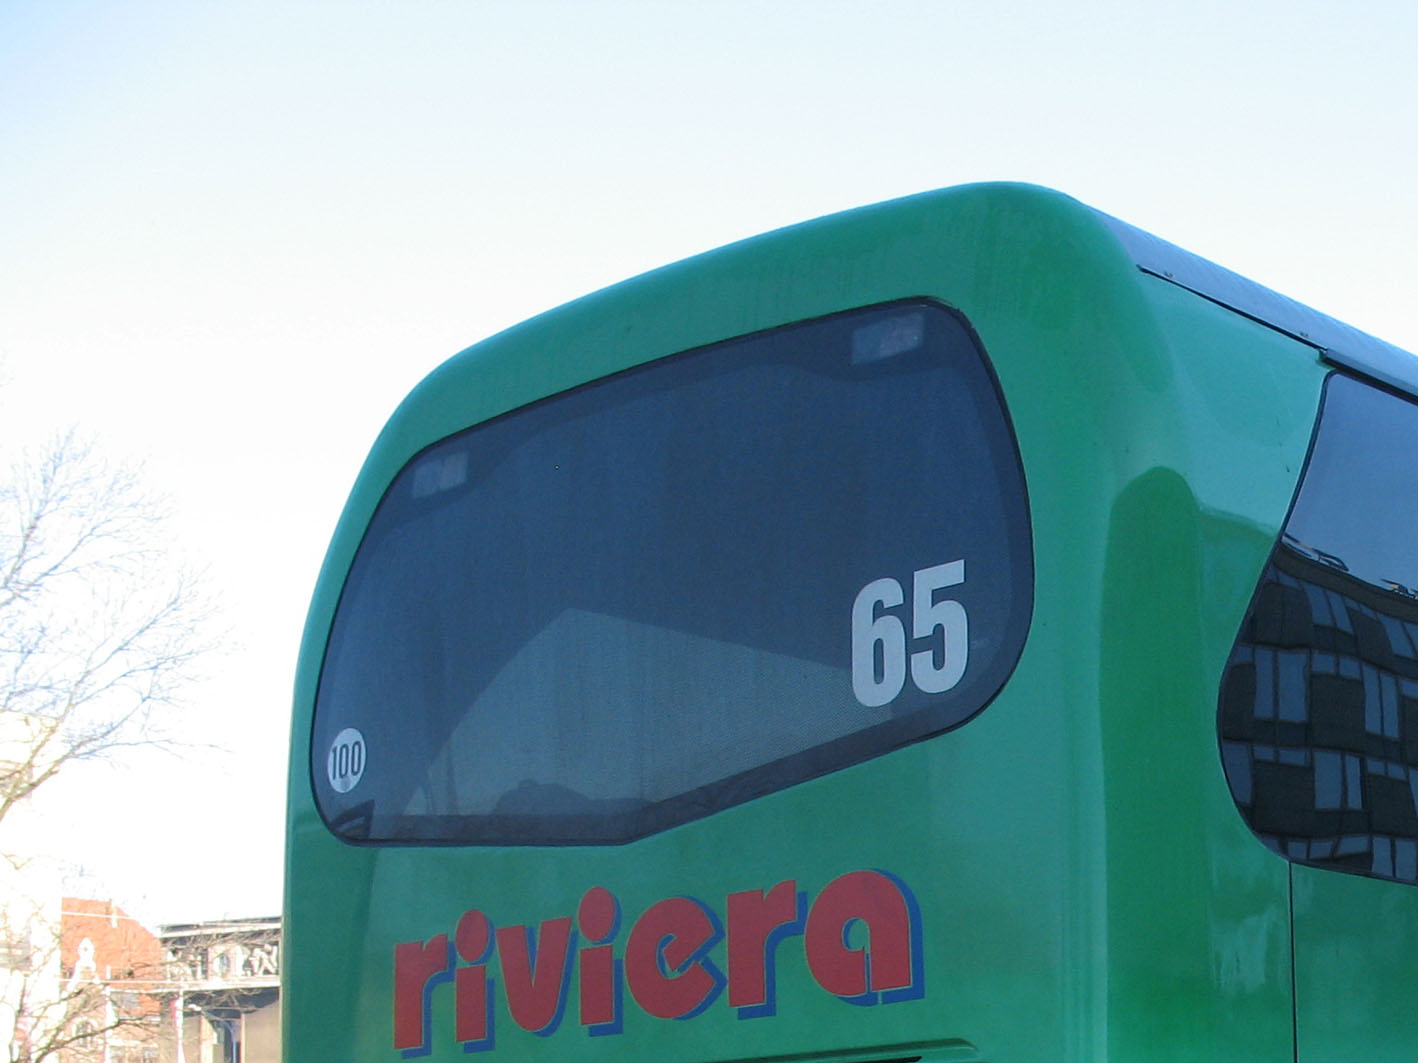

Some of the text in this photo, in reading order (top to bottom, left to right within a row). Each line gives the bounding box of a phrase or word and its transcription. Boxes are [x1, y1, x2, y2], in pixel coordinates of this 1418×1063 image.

[851, 559, 970, 707] 65
[331, 740, 362, 780] 100
[393, 868, 925, 1059] riviera
